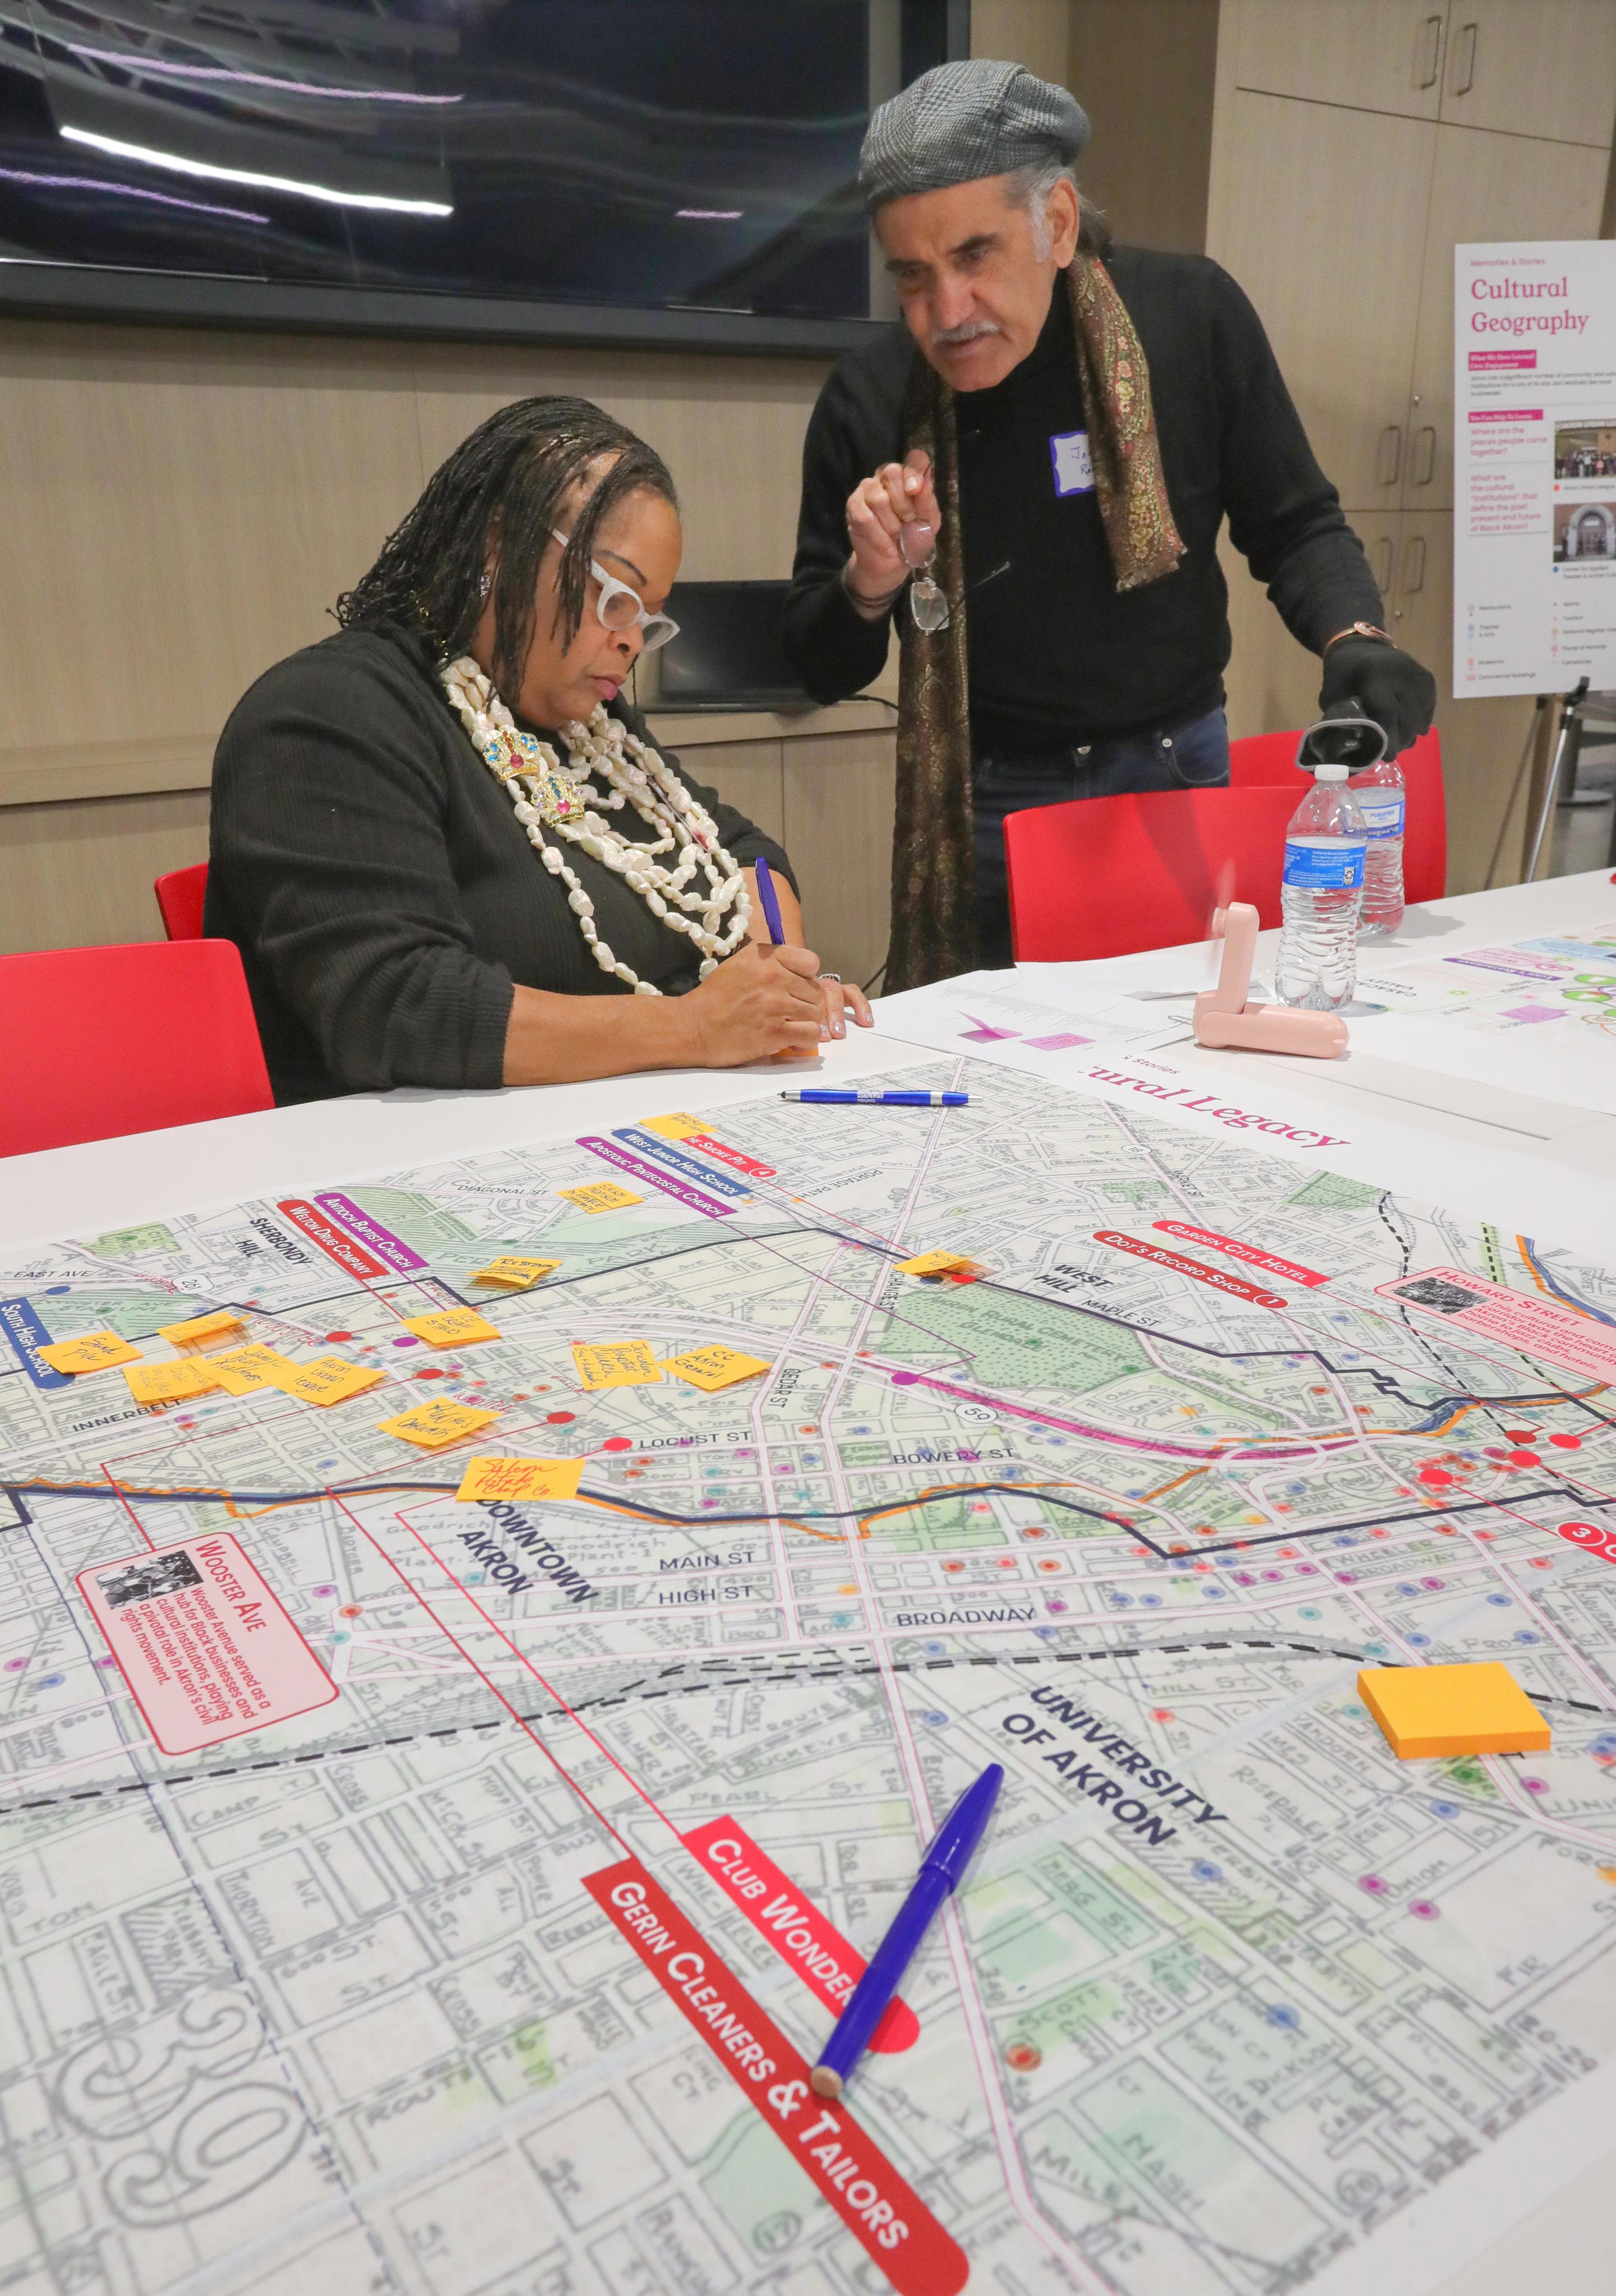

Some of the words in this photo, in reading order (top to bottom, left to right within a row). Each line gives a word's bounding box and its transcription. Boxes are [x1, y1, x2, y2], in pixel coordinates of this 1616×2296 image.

[1471, 276, 1569, 300] Cultural
[1471, 309, 1590, 336] Geography
[1363, 978, 1415, 990] VALLEY
[1133, 1057, 1181, 1075] Stories
[1178, 1095, 1352, 1149] Legacy
[625, 1133, 649, 1150] WEST
[647, 1145, 682, 1166] JUNIOR
[680, 1161, 704, 1177] HIGH
[700, 1173, 740, 1196] SCHOOL
[458, 1184, 526, 1195] DIAGONAL
[797, 1186, 832, 1198] PATH
[828, 1170, 883, 1189] PORTAGE
[682, 1192, 726, 1216] CHURCH
[250, 1217, 312, 1266] SHERBONDY
[289, 1205, 322, 1232] WELTON
[313, 1228, 340, 1247] DRUG
[332, 1244, 374, 1275] COMPANY
[322, 1198, 356, 1223] ANTIOCH
[351, 1220, 384, 1243] BAPTIST
[377, 1241, 415, 1269] CHURCH
[234, 1239, 264, 1258] HILL
[1167, 1224, 1222, 1247] GARDEN
[1223, 1243, 1261, 1261] CITY
[1259, 1258, 1308, 1281] HOTEL
[181, 1279, 204, 1290] 261
[1033, 1272, 1079, 1294] HILL
[1054, 1263, 1118, 1289] WEST
[1147, 1250, 1207, 1278] RECORD
[1205, 1274, 1252, 1295] SHOP
[1081, 1299, 1139, 1320] MAPLE
[1136, 1316, 1162, 1327] ST
[1436, 1271, 1515, 1303] HOWARD
[1517, 1301, 1583, 1327] STREET
[1, 1303, 24, 1333] SOUTH
[14, 1326, 36, 1349] HIGH
[1465, 1310, 1499, 1326] home
[1511, 1327, 1536, 1340] jazz
[1536, 1336, 1572, 1355] clubs,
[1472, 1308, 1515, 1327] Akron's
[1516, 1322, 1551, 1339] Black
[1481, 1304, 1528, 1327] corridor
[1527, 1323, 1553, 1334] was
[1553, 1330, 1575, 1343] the
[1575, 1339, 1608, 1354] heart
[1490, 1301, 1513, 1313] This
[1517, 1310, 1560, 1329] cultural
[1559, 1327, 1587, 1339] and
[1458, 1313, 1531, 1345] barbershops,
[1532, 1343, 1559, 1356] and
[1558, 1352, 1600, 1372] hotels.
[777, 1368, 801, 1396] CEDAR
[72, 1398, 181, 1432] INNERBELT
[770, 1396, 788, 1408] ST
[964, 1407, 990, 1420] 59
[639, 1433, 719, 1449] LOCUST
[727, 1431, 751, 1441] ST
[990, 1448, 1013, 1459] ST
[1572, 1527, 1592, 1538] 3
[456, 1529, 534, 1596] AKRON
[659, 1555, 719, 1571] MAIN
[728, 1551, 756, 1565] ST
[194, 1538, 248, 1602] WOOSTER
[233, 1601, 268, 1633] AVE
[658, 1589, 715, 1605] HIGH
[724, 1586, 754, 1600] ST
[173, 1592, 192, 1610] hub
[182, 1608, 197, 1621] for
[190, 1586, 219, 1621] Wooster
[139, 1608, 171, 1644] pivotal
[897, 1607, 1035, 1626] BROADWAY
[120, 1608, 144, 1634] rights
[135, 1631, 172, 1686] movement.
[158, 1637, 177, 1658] role
[190, 1621, 216, 1647] Black
[210, 1621, 238, 1656] Avenue
[156, 1598, 186, 1631] cultural
[173, 1628, 212, 1684] institutions,
[200, 1682, 234, 1722] playing
[168, 1656, 184, 1668] in
[204, 1645, 243, 1699] businesses
[230, 1654, 262, 1689] served
[174, 1667, 202, 1705] Akron's
[251, 1688, 266, 1701] as
[194, 1703, 221, 1726] civil
[235, 1698, 259, 1720] and
[258, 1701, 272, 1709] a
[1029, 1685, 1230, 1825] UNIVERSITY
[1001, 1714, 1056, 1745] OF
[1042, 1750, 1181, 1846] AKRON
[707, 1838, 768, 1901] CLUB
[610, 1880, 677, 1956] GERIN
[667, 1951, 778, 2083] CLEANERS
[767, 2078, 809, 2120] &
[798, 2109, 911, 2250] TAILORS
